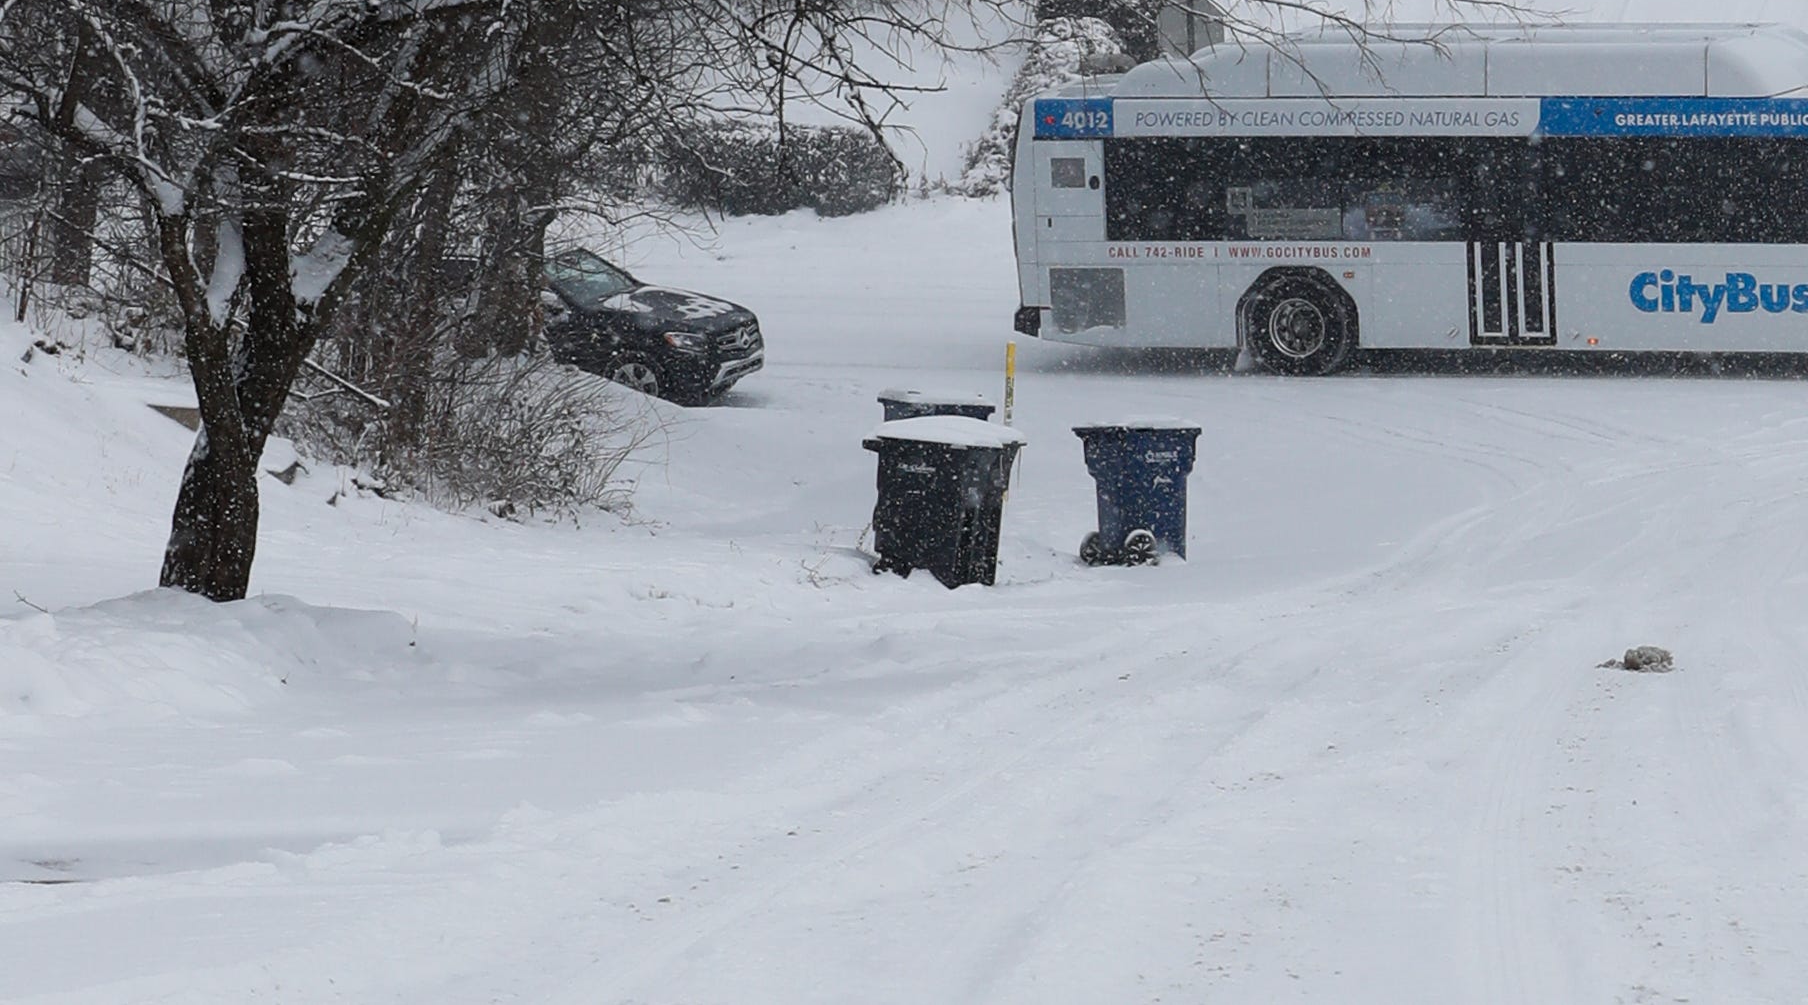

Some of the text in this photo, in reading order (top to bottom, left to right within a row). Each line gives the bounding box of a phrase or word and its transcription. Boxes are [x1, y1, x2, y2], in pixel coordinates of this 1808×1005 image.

[1061, 111, 1109, 129] 4012
[1135, 111, 1520, 127] POWERED BY CLEAN COMPRESSED NATURAL GAS
[1615, 113, 1680, 127] GREATER
[1682, 113, 1757, 126] LAFAYETTE
[1108, 247, 1139, 258] CALL
[1144, 246, 1205, 258] 742-RIDE
[1228, 246, 1371, 258] WWW.GOCITYBUS.COM
